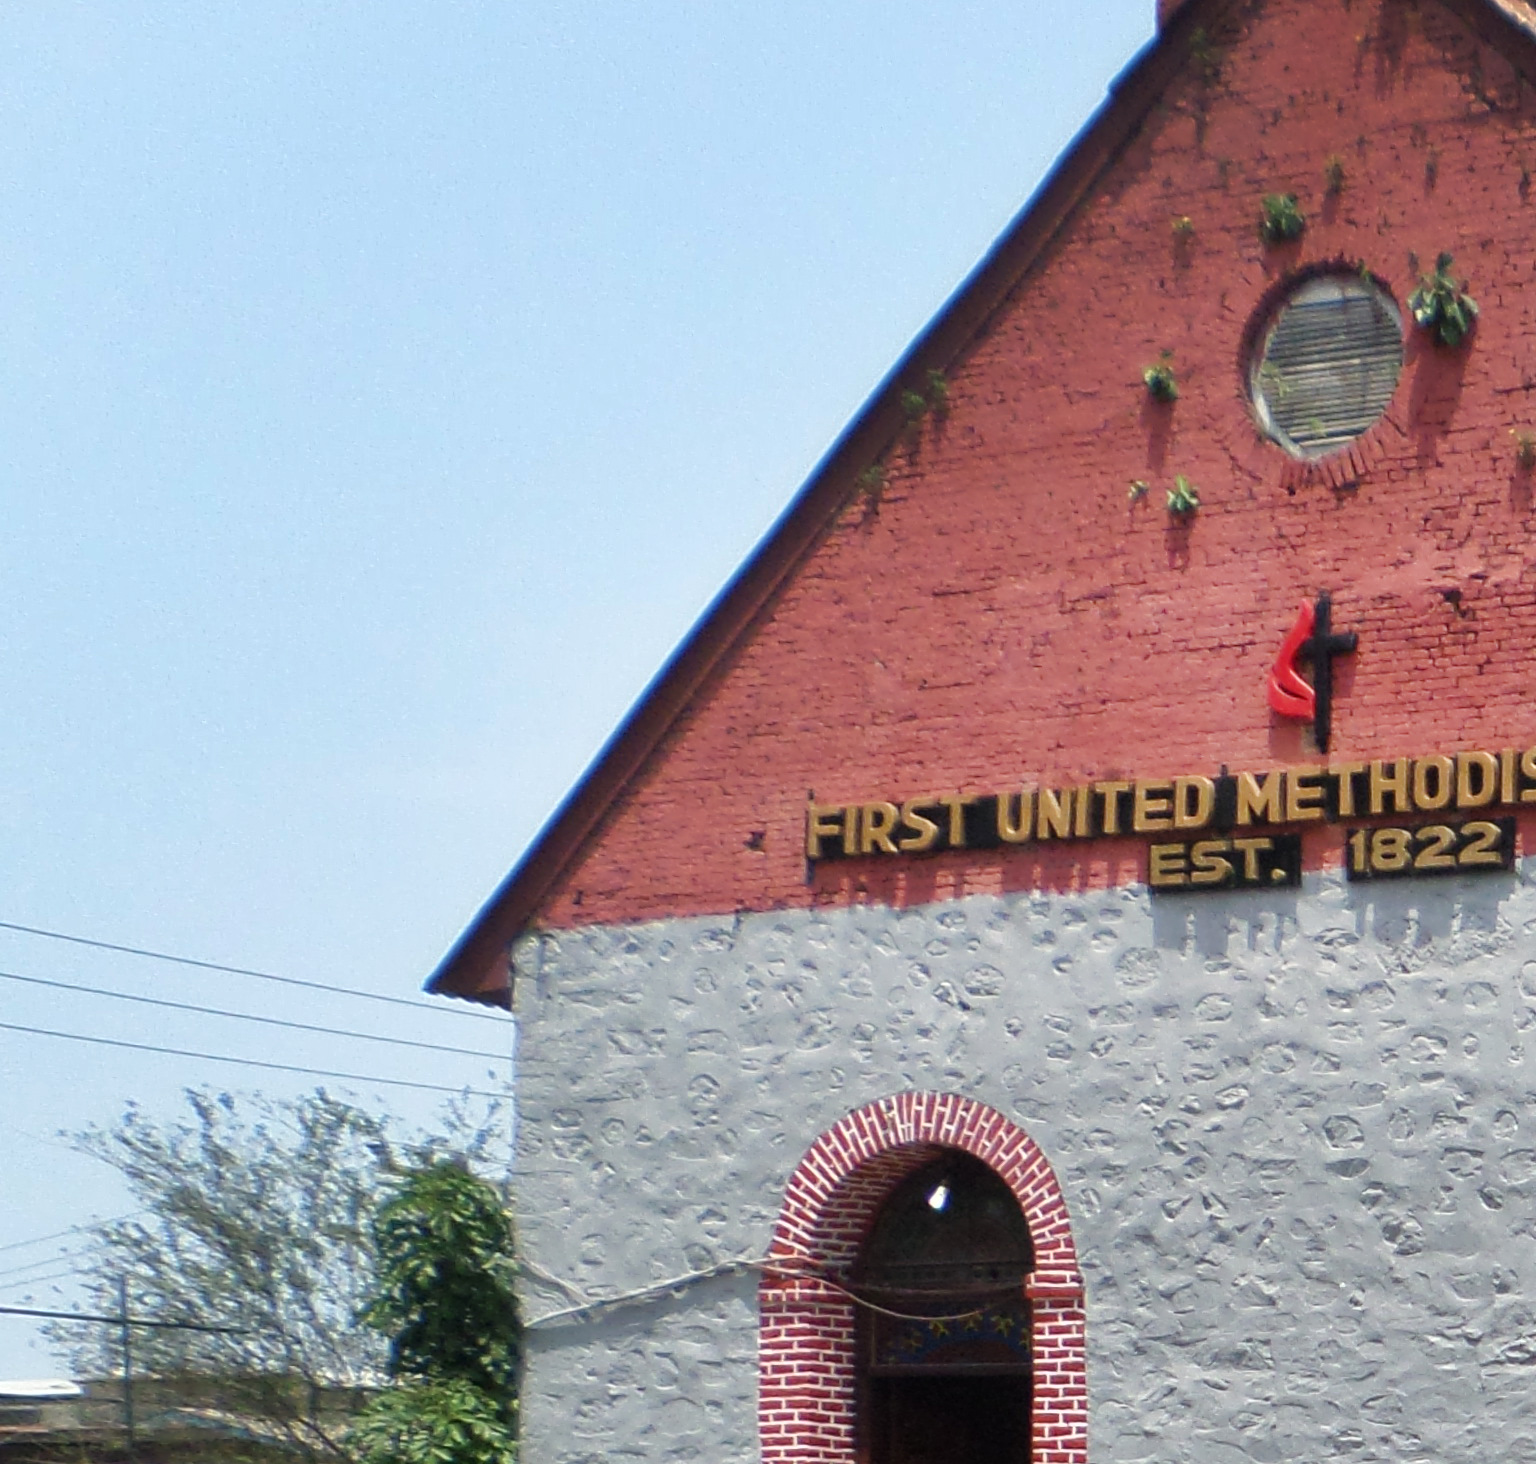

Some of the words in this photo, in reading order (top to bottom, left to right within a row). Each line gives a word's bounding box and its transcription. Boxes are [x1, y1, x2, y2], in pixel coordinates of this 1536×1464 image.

[806, 796, 974, 856] FIRST
[997, 774, 1215, 843] UNITED
[1149, 837, 1287, 886] EST.
[1348, 820, 1502, 873] 1822
